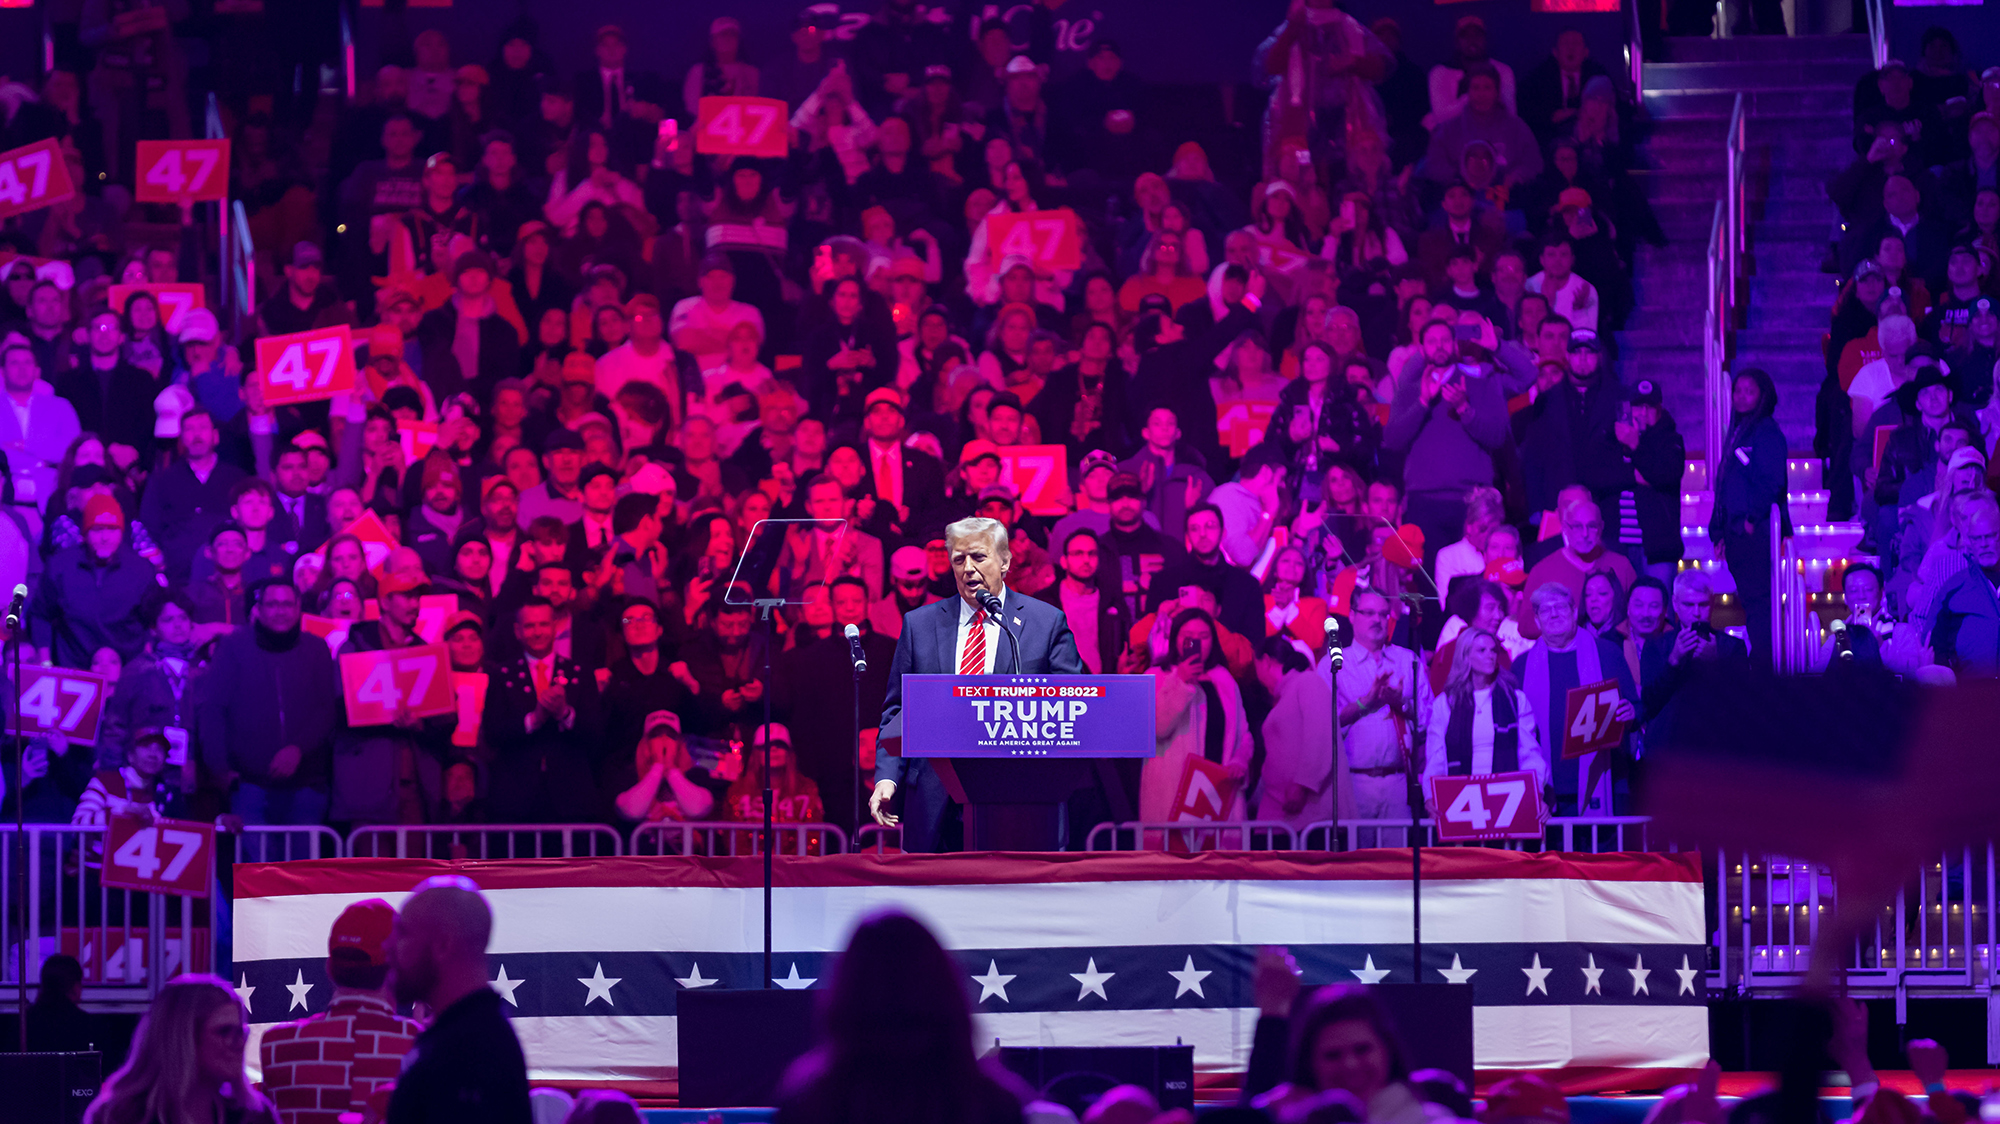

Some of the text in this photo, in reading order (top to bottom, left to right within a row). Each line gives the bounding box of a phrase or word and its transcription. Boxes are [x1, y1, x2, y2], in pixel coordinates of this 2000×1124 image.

[706, 104, 778, 145] 47
[0, 149, 51, 205] 47
[146, 149, 219, 192] 47
[1000, 219, 1065, 260] 47
[157, 292, 194, 335] 7
[268, 337, 342, 391] 47
[14, 675, 98, 732] 47
[356, 655, 437, 710] 47
[957, 686, 1099, 697] TEXT TRUMP TO 88022
[971, 700, 1088, 722] TRUMP
[984, 721, 1074, 739] VANCE
[1570, 688, 1620, 743] 47
[1445, 780, 1526, 830] 47
[113, 827, 203, 882] 47
[72, 1088, 93, 1097] NEXO
[1165, 1081, 1187, 1090] NEXO
